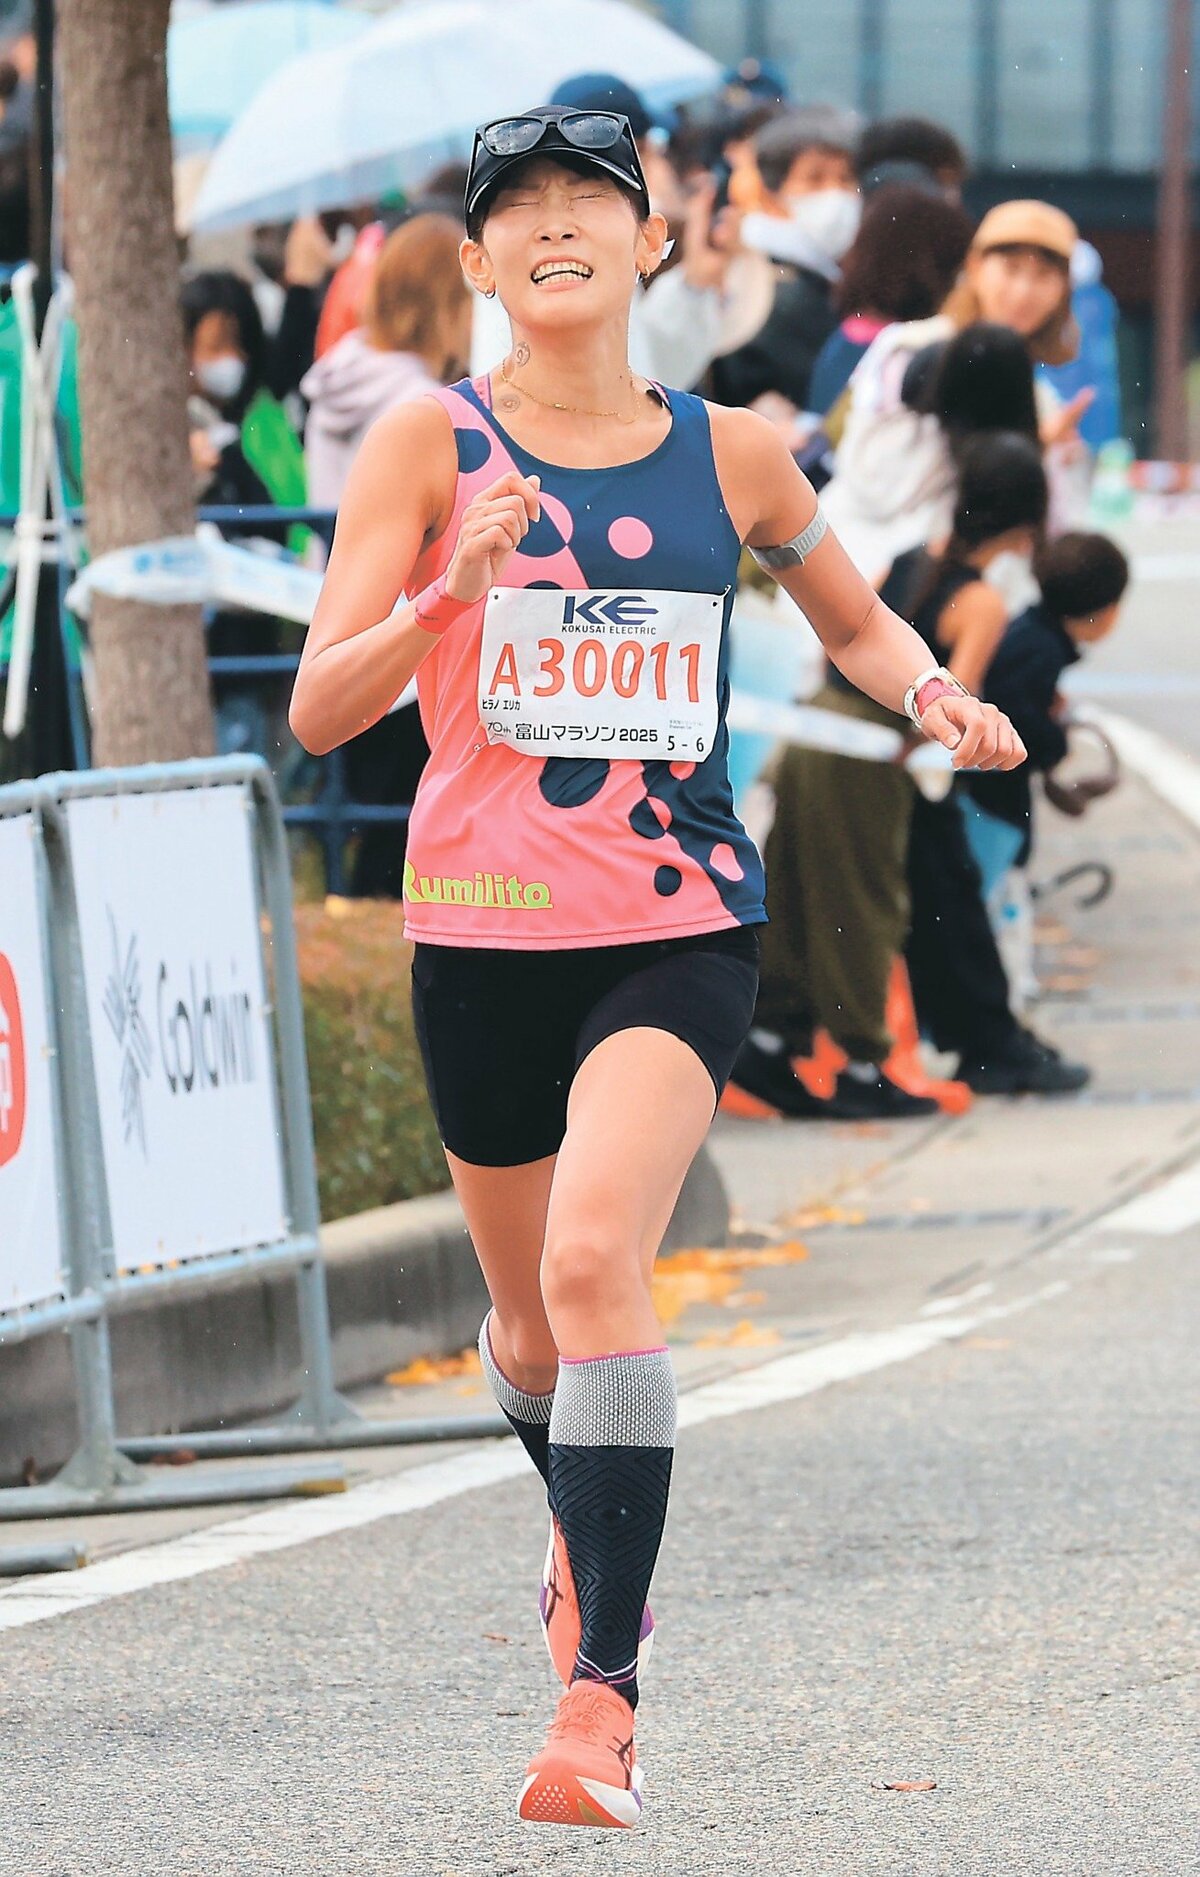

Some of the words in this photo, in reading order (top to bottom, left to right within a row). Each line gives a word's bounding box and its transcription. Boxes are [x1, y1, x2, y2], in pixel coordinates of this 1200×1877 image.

[561, 625, 606, 633] KOKUSAI
[609, 626, 657, 635] ELECTRIC
[482, 699, 499, 710] ヒラノ
[503, 700, 520, 710] エリカ
[404, 858, 554, 910] Rumilito
